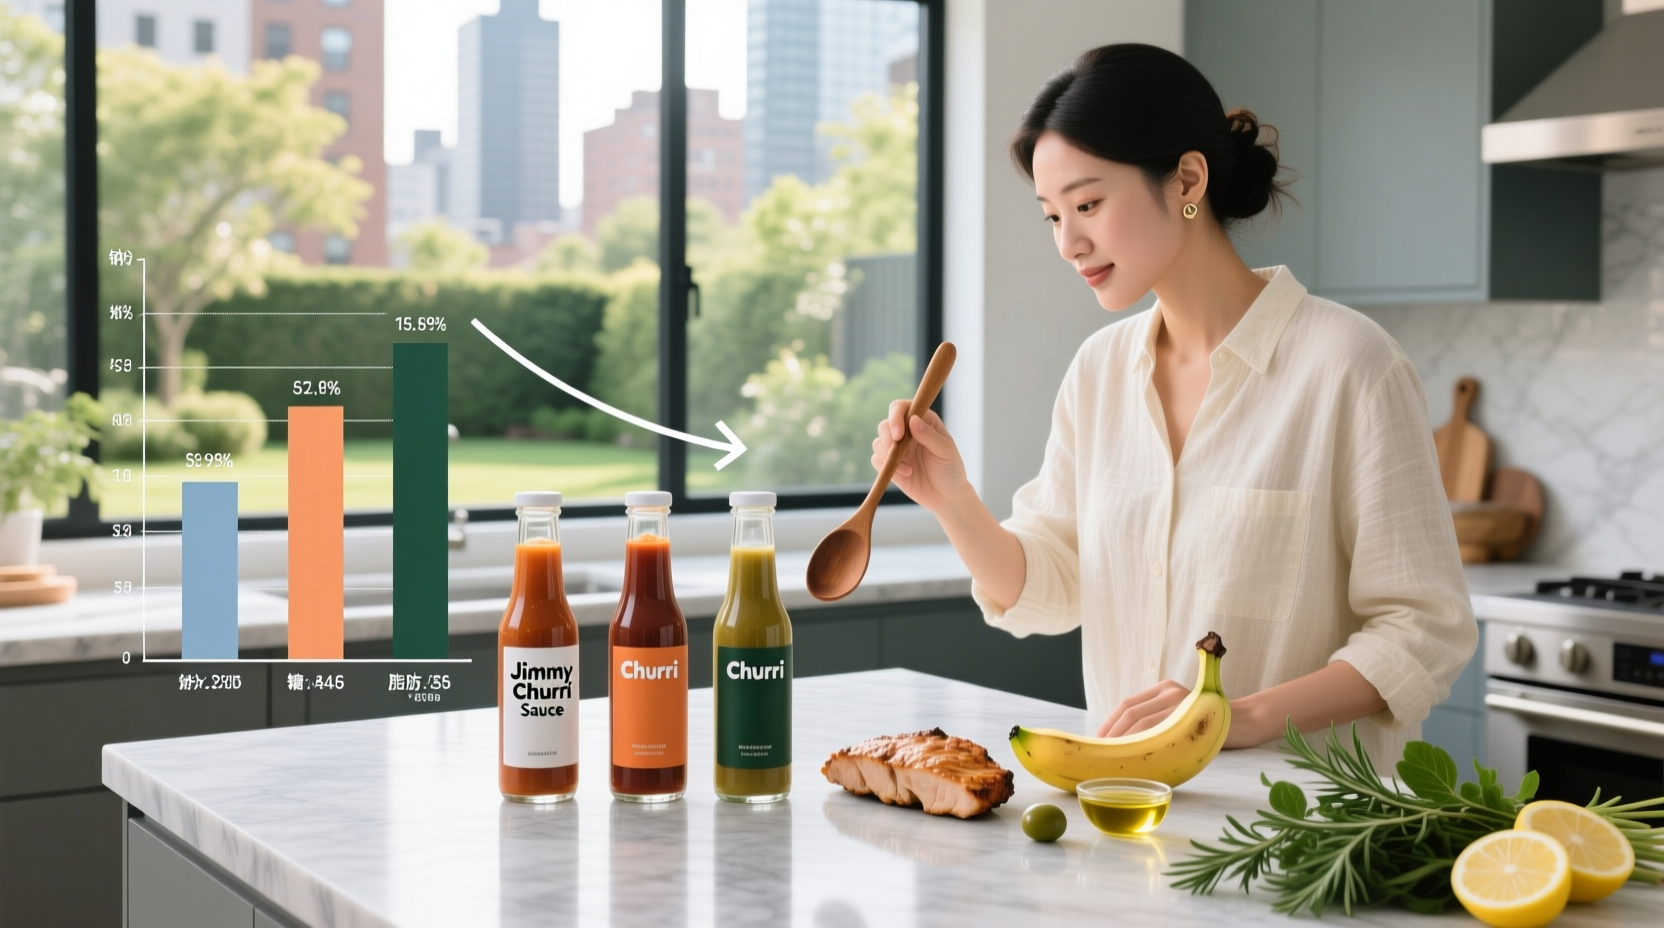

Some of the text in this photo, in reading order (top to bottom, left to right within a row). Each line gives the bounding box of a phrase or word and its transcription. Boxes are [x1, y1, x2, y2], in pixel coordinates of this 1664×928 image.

[510, 661, 573, 684] Jimmy
[620, 659, 679, 680] Churri
[726, 659, 785, 680] Churri
[520, 702, 565, 717] Sauce
